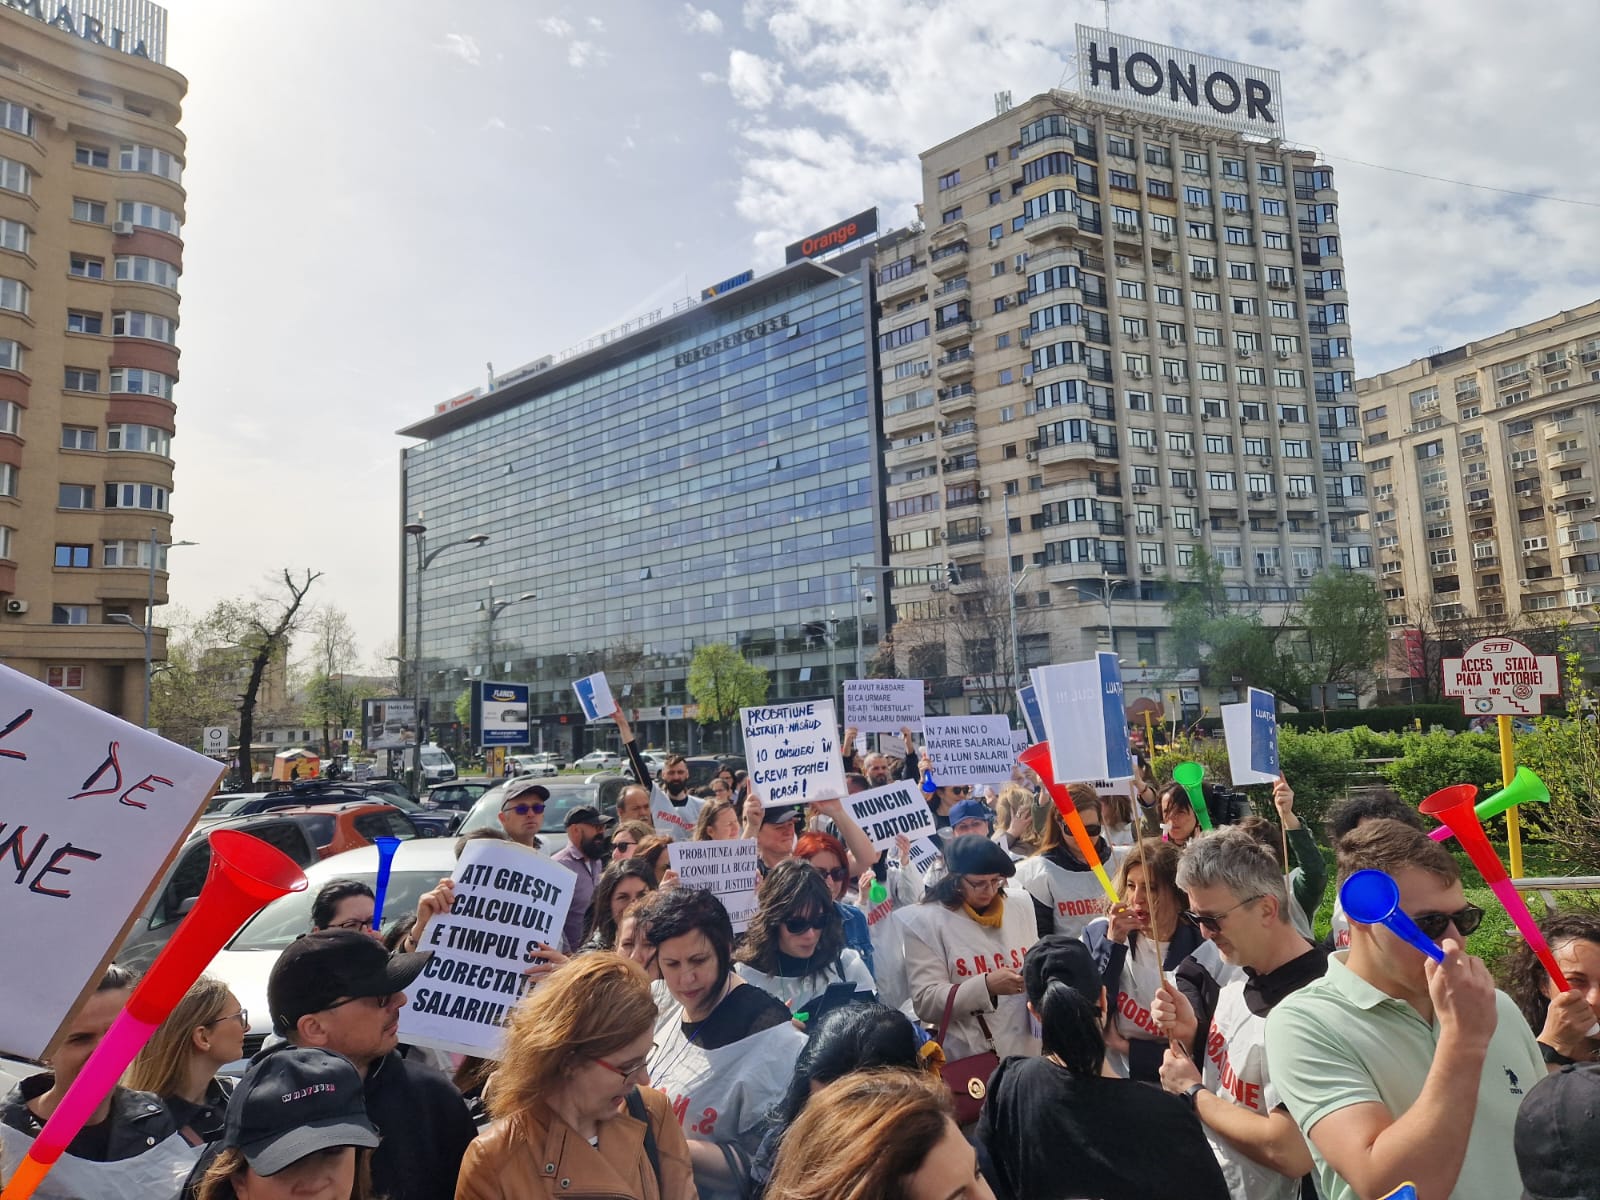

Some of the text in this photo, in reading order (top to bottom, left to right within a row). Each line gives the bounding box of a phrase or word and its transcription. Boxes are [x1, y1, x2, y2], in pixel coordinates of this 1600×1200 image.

[1089, 42, 1275, 123] HONOR
[802, 222, 857, 255] Orange
[1482, 643, 1510, 653] STB
[1461, 659, 1493, 672] ACCES
[1493, 671, 1543, 686] VICTORIEI
[937, 727, 942, 735] 7
[945, 726, 959, 735] ANI
[962, 725, 979, 734] NICI
[980, 725, 988, 734] O
[757, 749, 768, 763] 10
[929, 750, 1008, 762] DE 4 LUNI SALARII
[67, 741, 174, 809] DE
[754, 768, 788, 784] GREVA
[852, 789, 912, 819] MUNCIM
[873, 809, 930, 841] DATORIE
[680, 864, 718, 878] ECONOMII
[721, 863, 731, 874] LA
[459, 864, 562, 906] AȚI GREȘIT
[451, 894, 553, 934] CALCULUL!
[430, 923, 446, 945] E
[449, 926, 520, 961] TIMPUL
